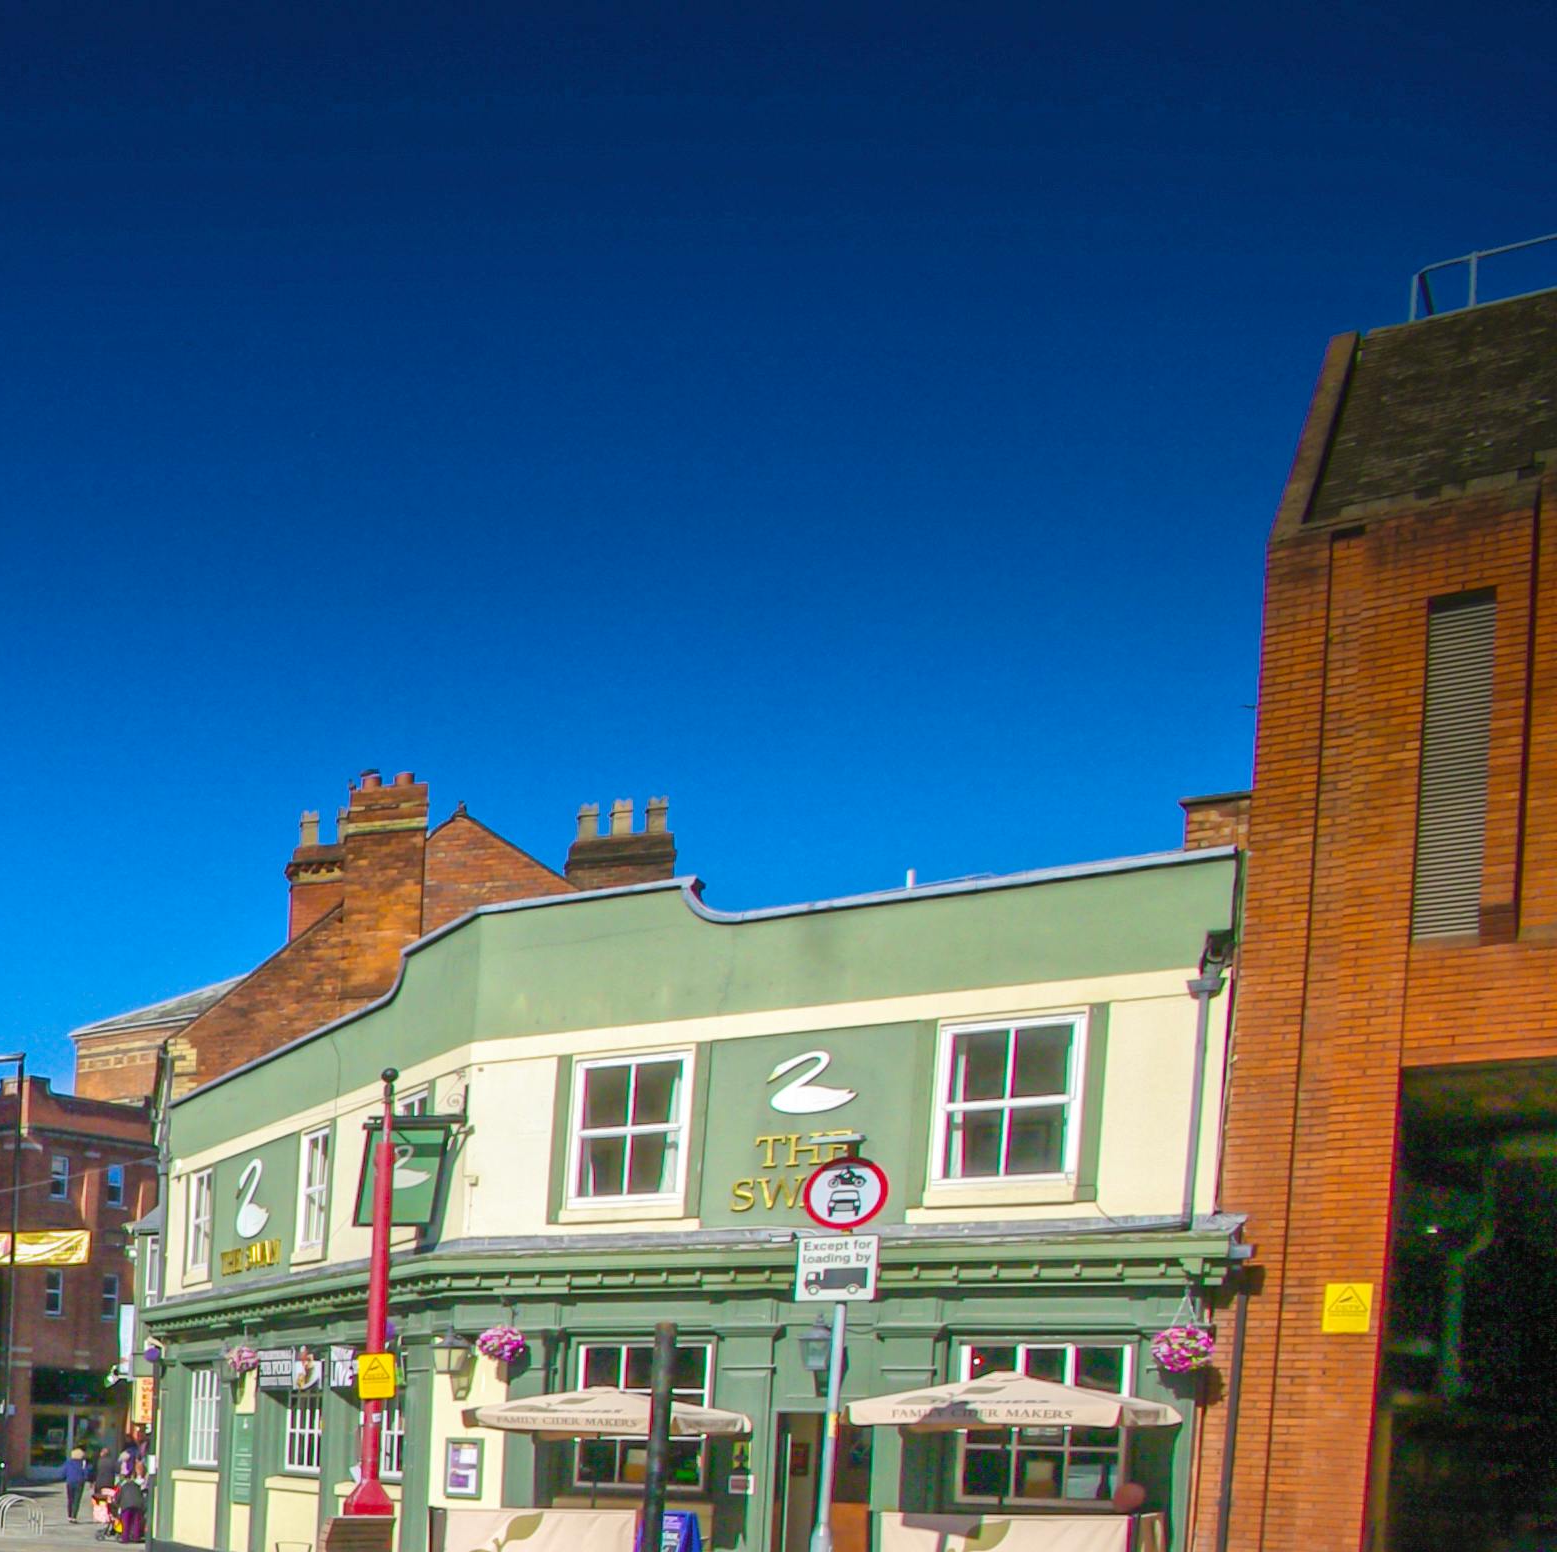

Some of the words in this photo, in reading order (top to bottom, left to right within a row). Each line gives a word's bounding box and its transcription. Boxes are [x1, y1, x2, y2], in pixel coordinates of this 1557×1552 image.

[756, 1129, 853, 1168] THE
[730, 1175, 807, 1212] SW
[803, 1240, 850, 1252] Except
[853, 1240, 873, 1250] for
[802, 1253, 851, 1264] loading
[855, 1252, 872, 1264] by
[891, 1408, 943, 1419] FAMILY
[951, 1408, 999, 1419] CIDER
[1006, 1408, 1074, 1419] MAKERS
[496, 1416, 538, 1425] FAMILY
[542, 1416, 580, 1426] CIDER
[585, 1417, 638, 1428] MAKERS
